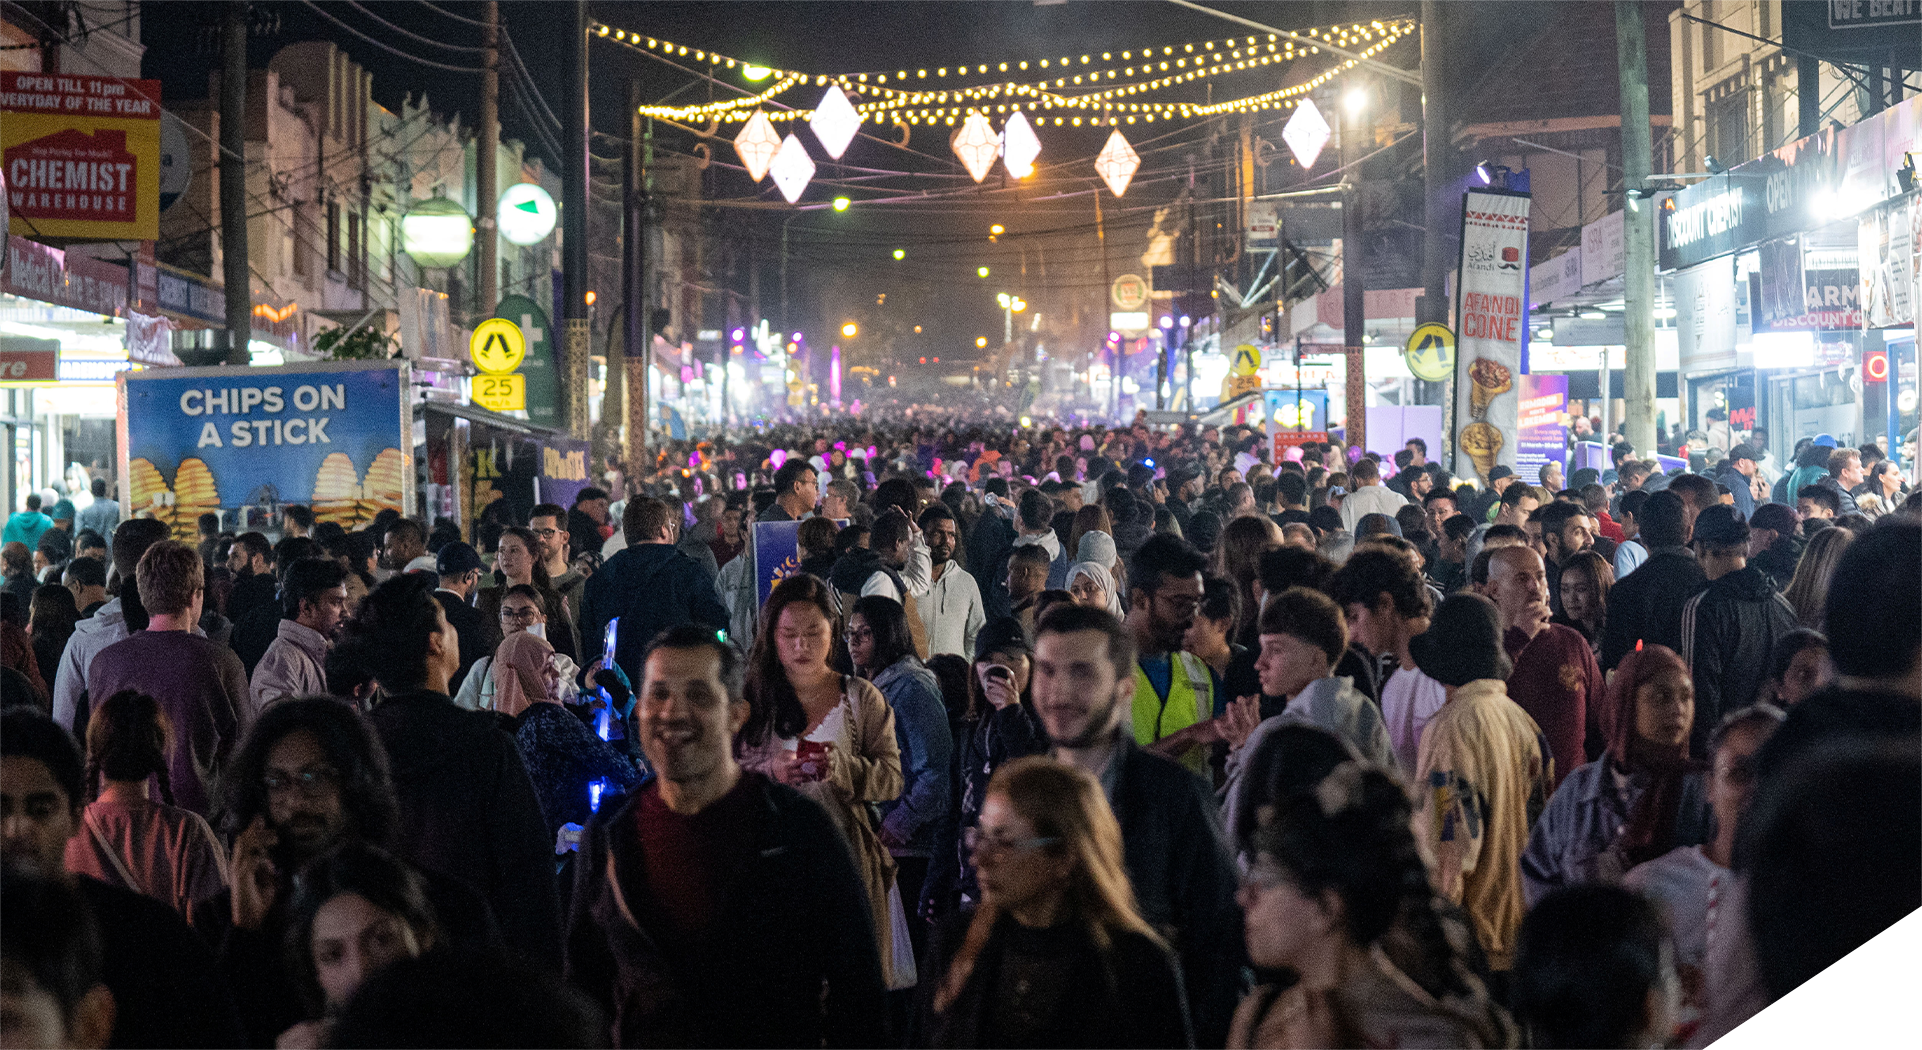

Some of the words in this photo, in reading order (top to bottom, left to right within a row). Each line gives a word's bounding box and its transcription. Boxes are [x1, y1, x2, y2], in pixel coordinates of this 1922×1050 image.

[16, 75, 54, 91] OPEN
[58, 78, 85, 93] TILL
[0, 91, 62, 109] VERYDAY
[65, 96, 85, 110] OF
[86, 97, 112, 112] THE
[115, 99, 151, 114] YEAR
[11, 157, 132, 192] CHEMIST
[11, 191, 127, 212] WAREHOUSE
[1766, 166, 1793, 214] OPEN
[1666, 201, 1706, 250] DISCOUNT
[1707, 186, 1743, 237] CHEMIST
[10, 246, 50, 295] Medical
[1464, 292, 1520, 315] AFANDI
[1464, 312, 1519, 342] CONE
[483, 379, 512, 396] 25
[1236, 377, 1255, 389] 25
[180, 386, 285, 416] CHIPS
[293, 384, 346, 411] ON
[1519, 412, 1557, 427] LAKEMBA
[197, 422, 223, 448] A
[232, 418, 331, 448] STICK
